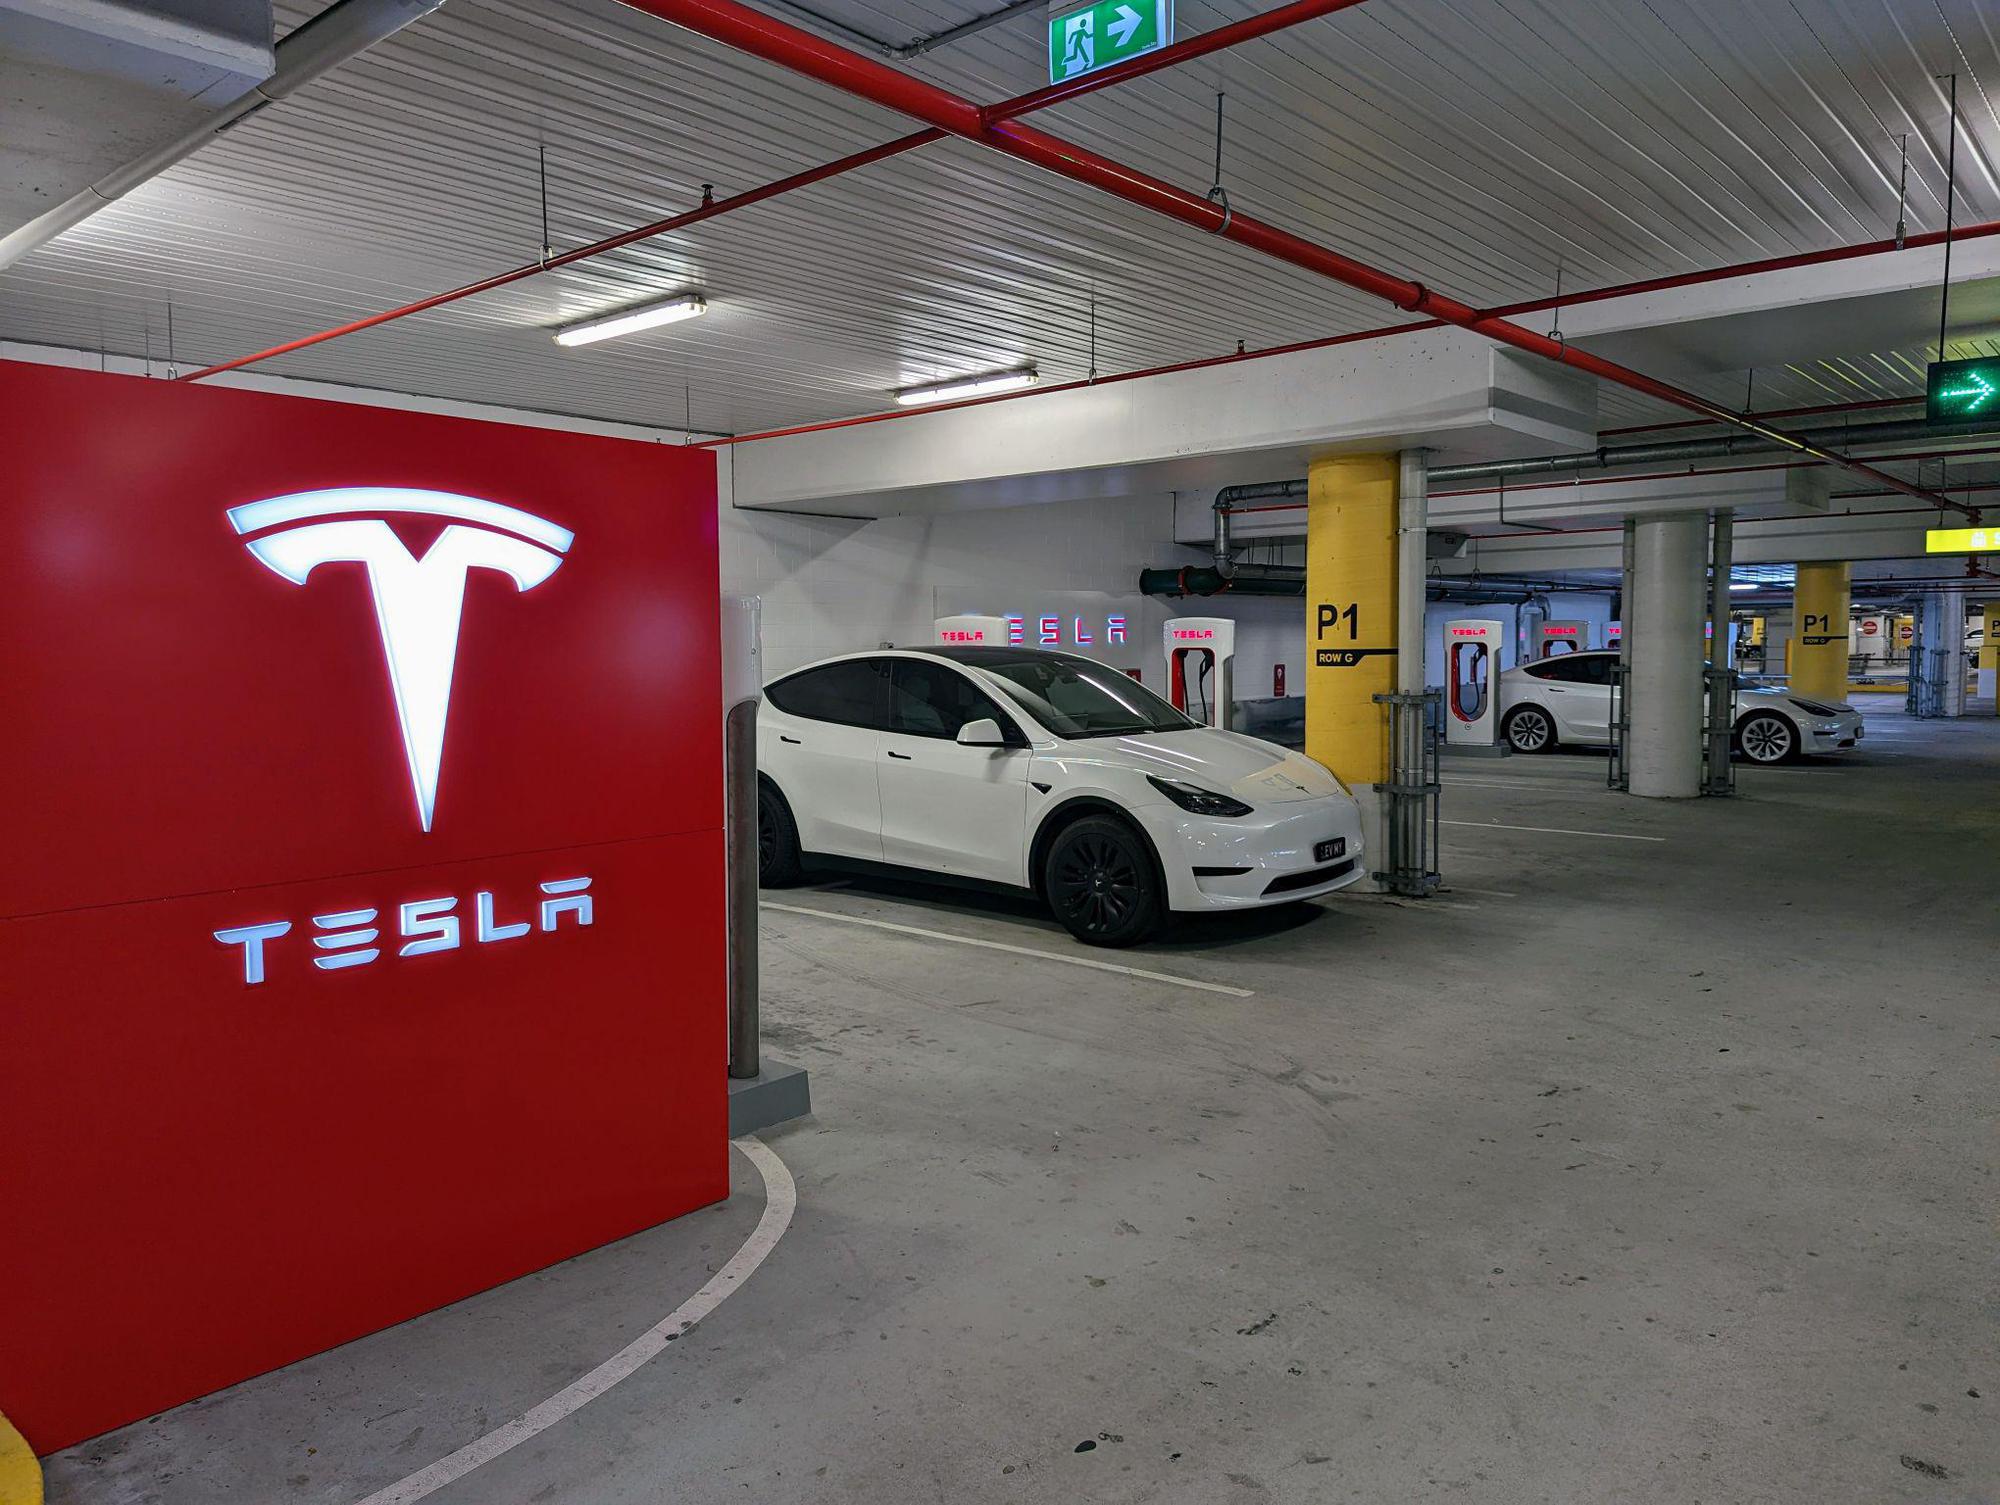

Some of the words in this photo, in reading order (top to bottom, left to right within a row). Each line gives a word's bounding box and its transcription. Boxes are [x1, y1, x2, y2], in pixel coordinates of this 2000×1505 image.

[1318, 603, 1358, 640] P1
[1804, 614, 1828, 632] P1
[940, 630, 984, 641] TESLA
[1007, 616, 1128, 647] ESLA
[1172, 630, 1213, 639] TESLA
[1452, 628, 1487, 636] TESLA
[1543, 626, 1577, 635] TESLA
[1319, 653, 1341, 663] ROW
[1344, 653, 1354, 663] G
[213, 876, 593, 984] TESLA
